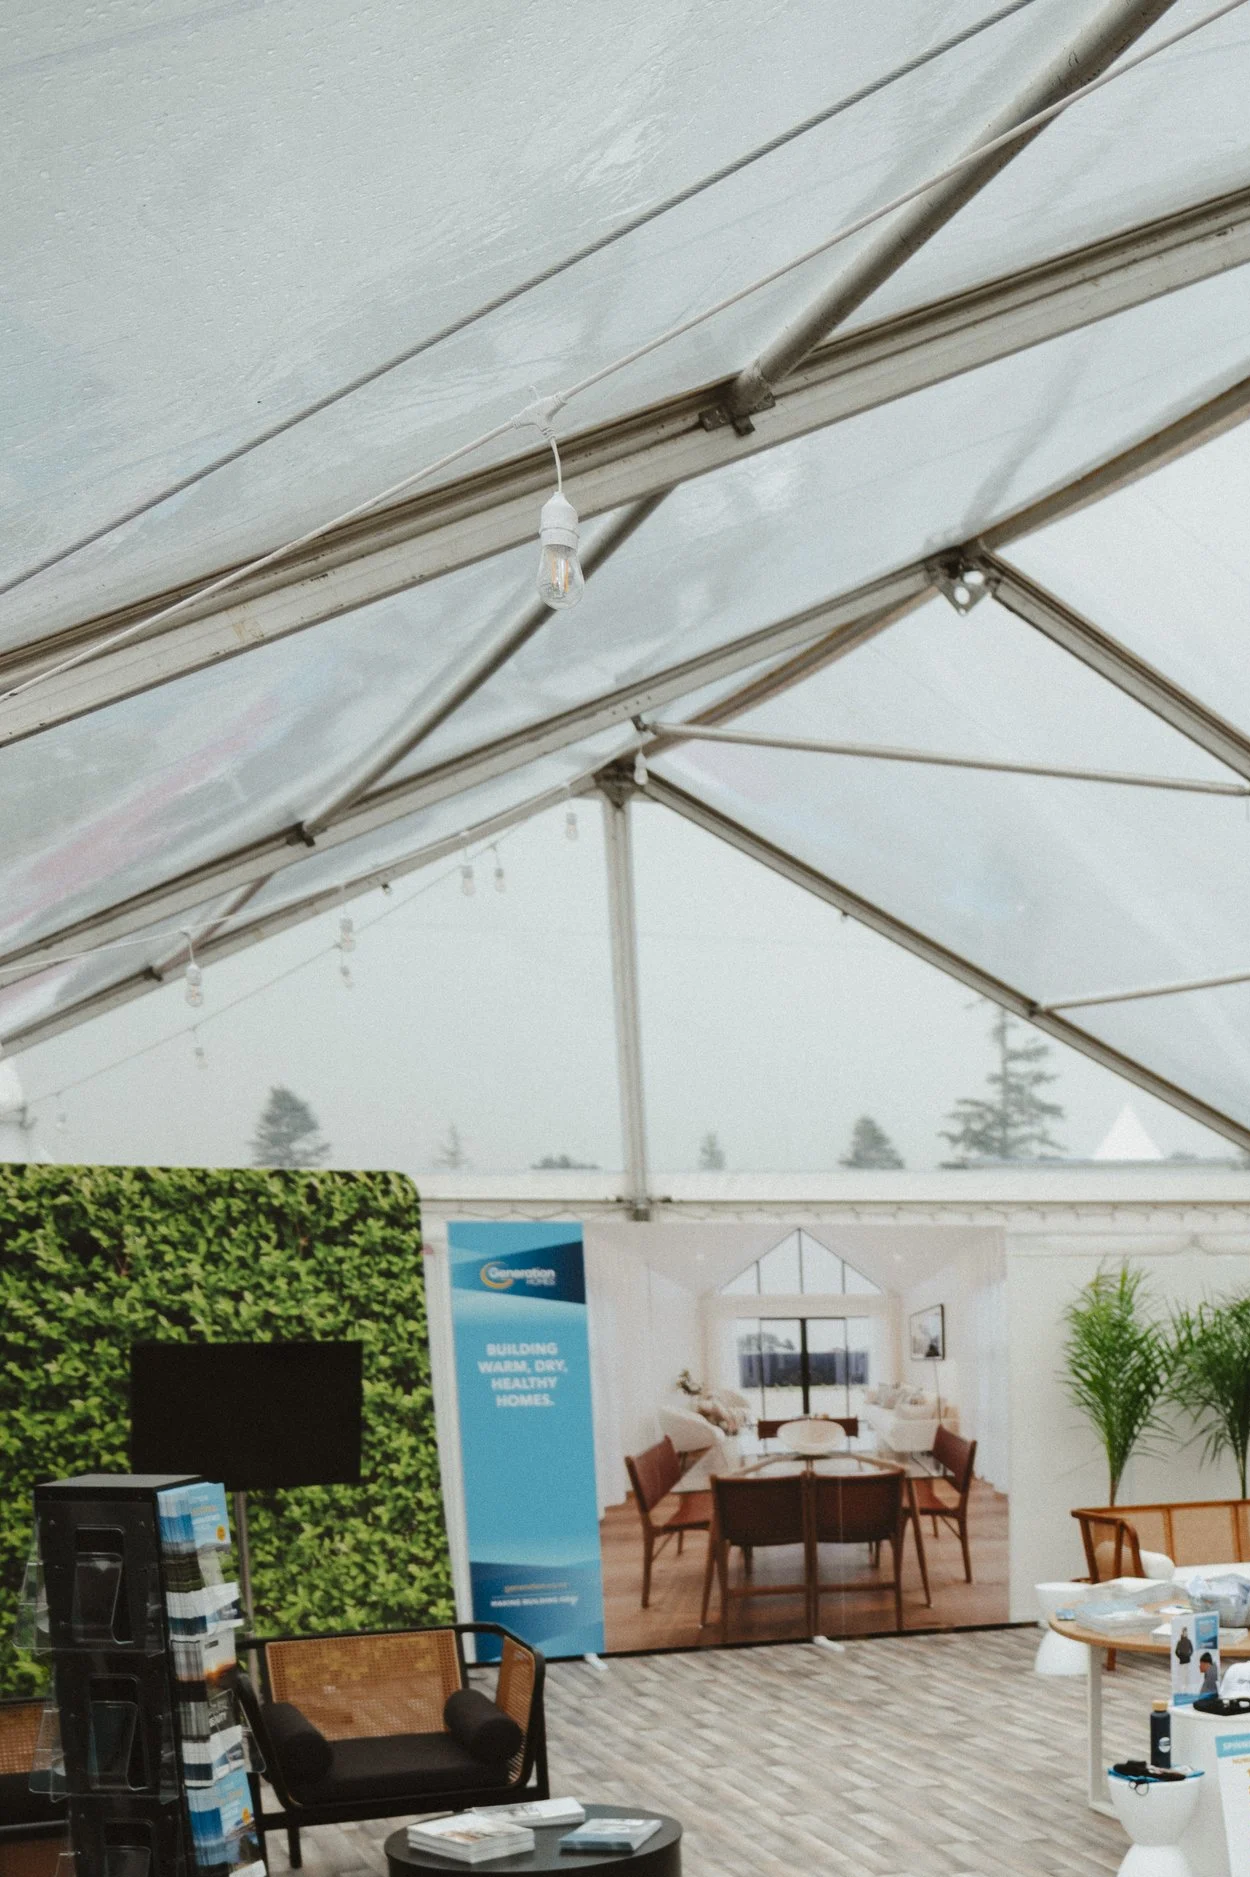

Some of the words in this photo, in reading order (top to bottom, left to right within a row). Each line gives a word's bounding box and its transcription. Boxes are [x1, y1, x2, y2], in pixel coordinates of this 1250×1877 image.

[488, 1266, 556, 1279] Generation
[486, 1342, 558, 1356] BUILDING
[477, 1360, 531, 1374] WARM,
[535, 1359, 568, 1373] DRY,
[491, 1376, 558, 1390] HEALTHY
[496, 1393, 556, 1408] HOMES.
